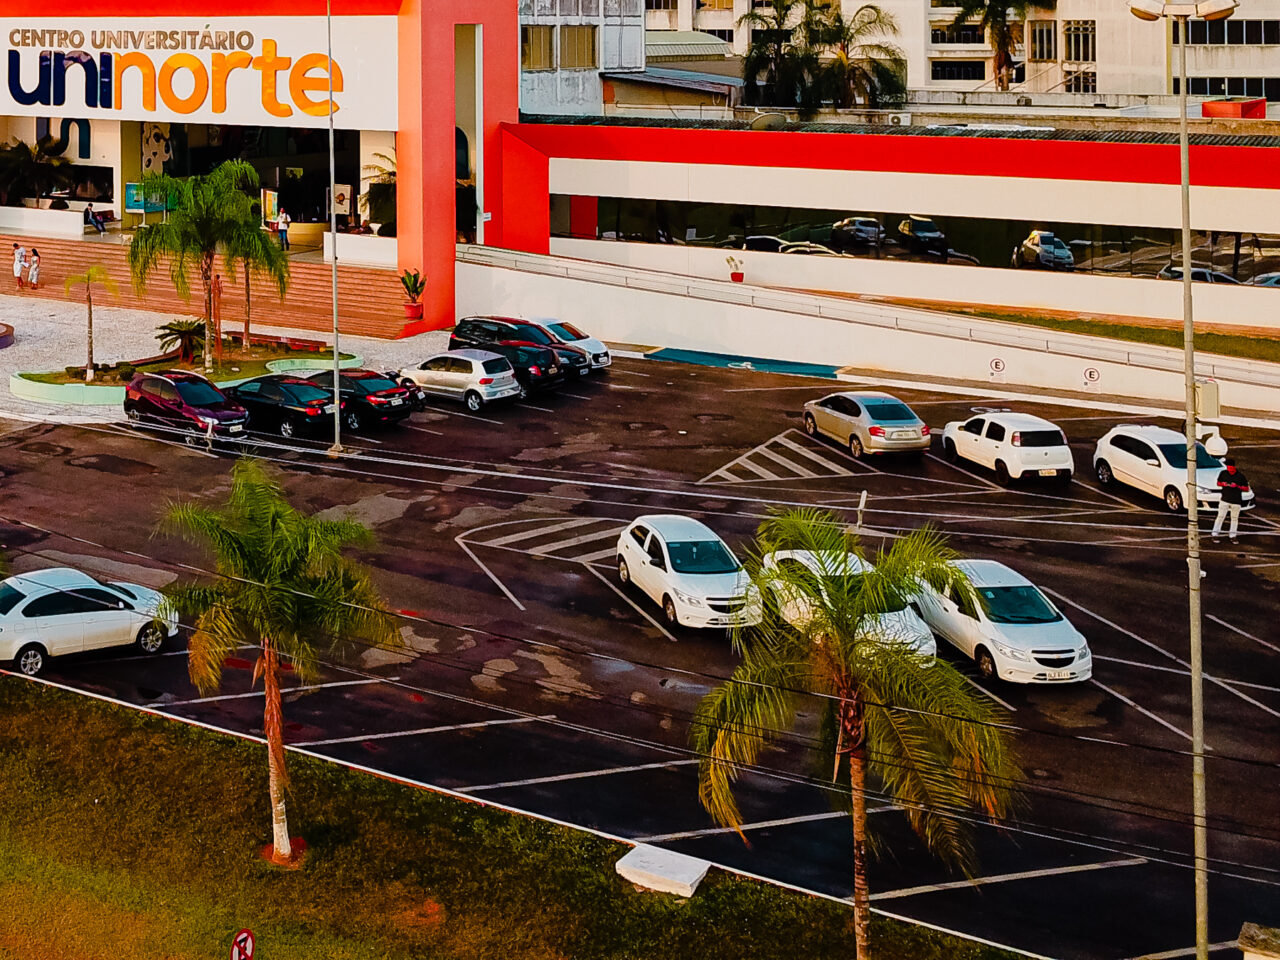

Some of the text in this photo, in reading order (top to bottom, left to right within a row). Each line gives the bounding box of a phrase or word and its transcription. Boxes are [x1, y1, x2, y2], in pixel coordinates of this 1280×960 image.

[9, 24, 254, 51] CENTRO UNIVERSITÁRIO
[7, 38, 344, 118] uninorte
